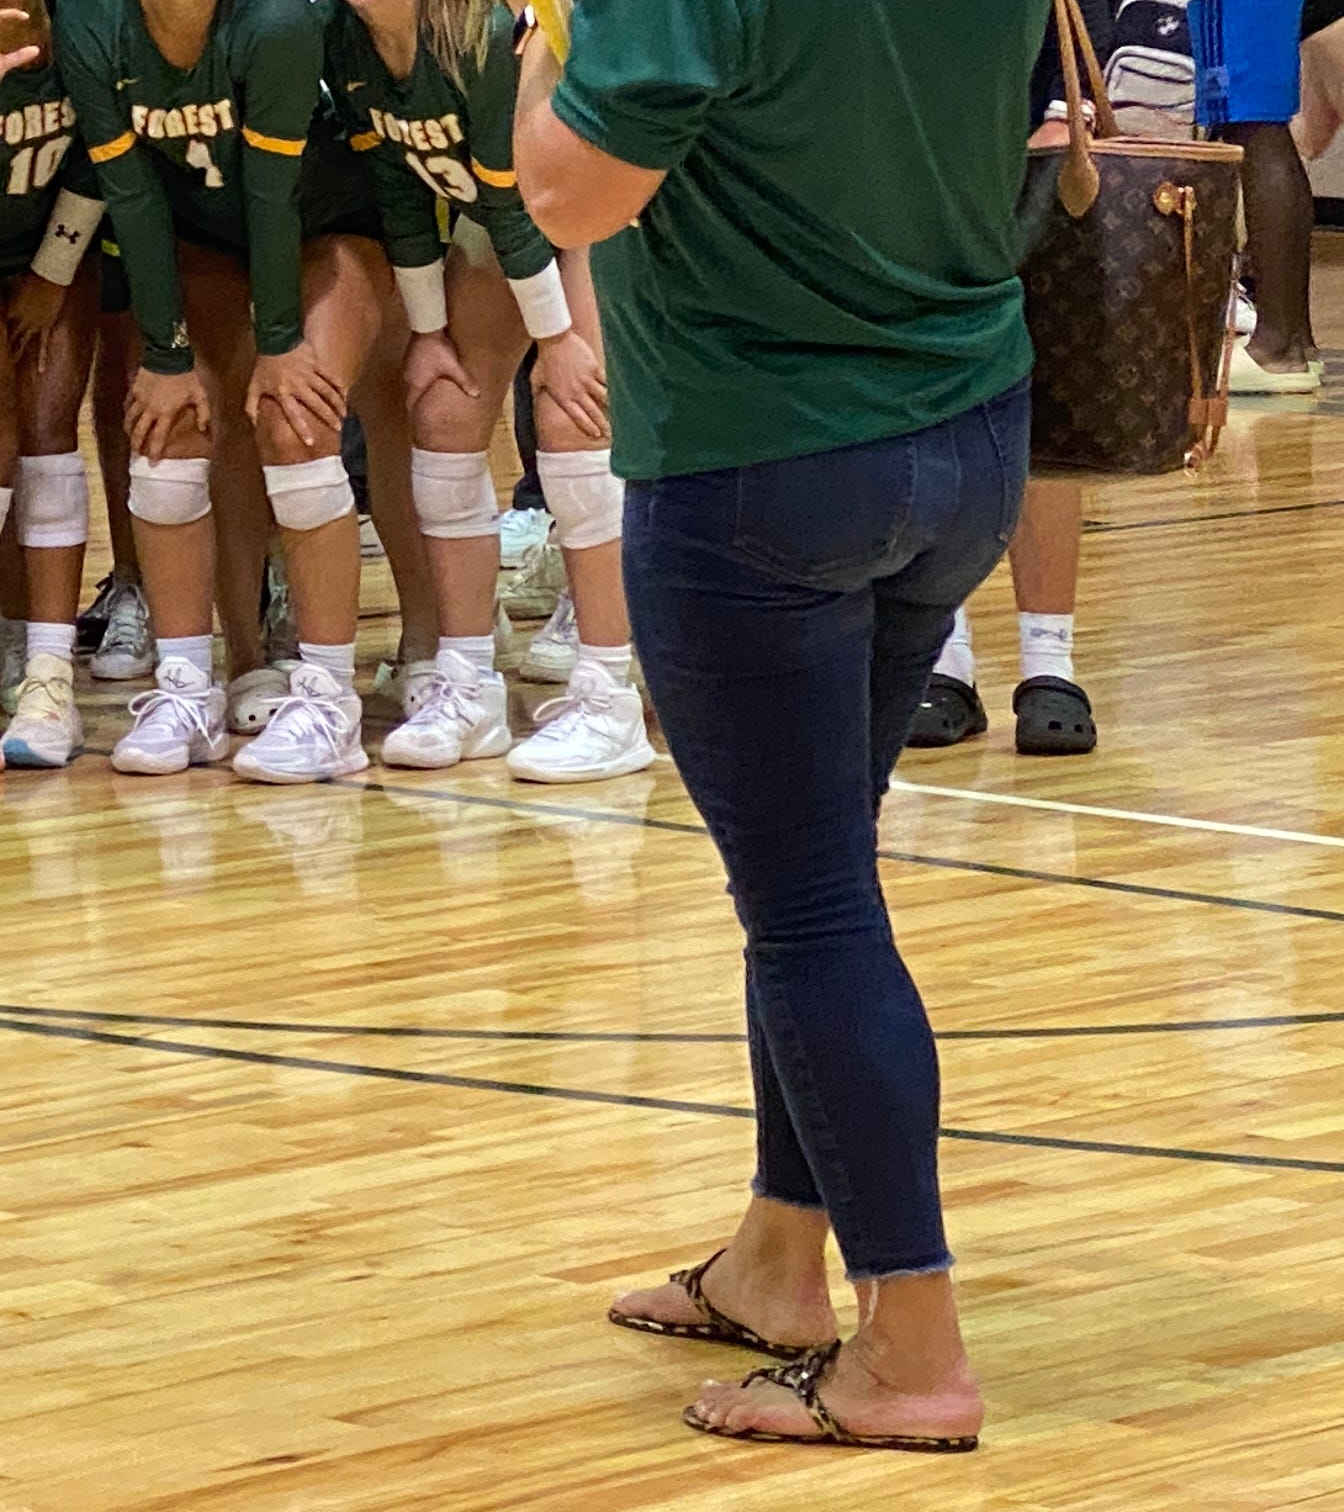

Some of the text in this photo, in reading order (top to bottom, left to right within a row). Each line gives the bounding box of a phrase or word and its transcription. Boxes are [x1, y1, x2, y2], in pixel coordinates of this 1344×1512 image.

[131, 98, 234, 139] FOREST
[6, 134, 72, 195] 10
[404, 151, 478, 203] 13
